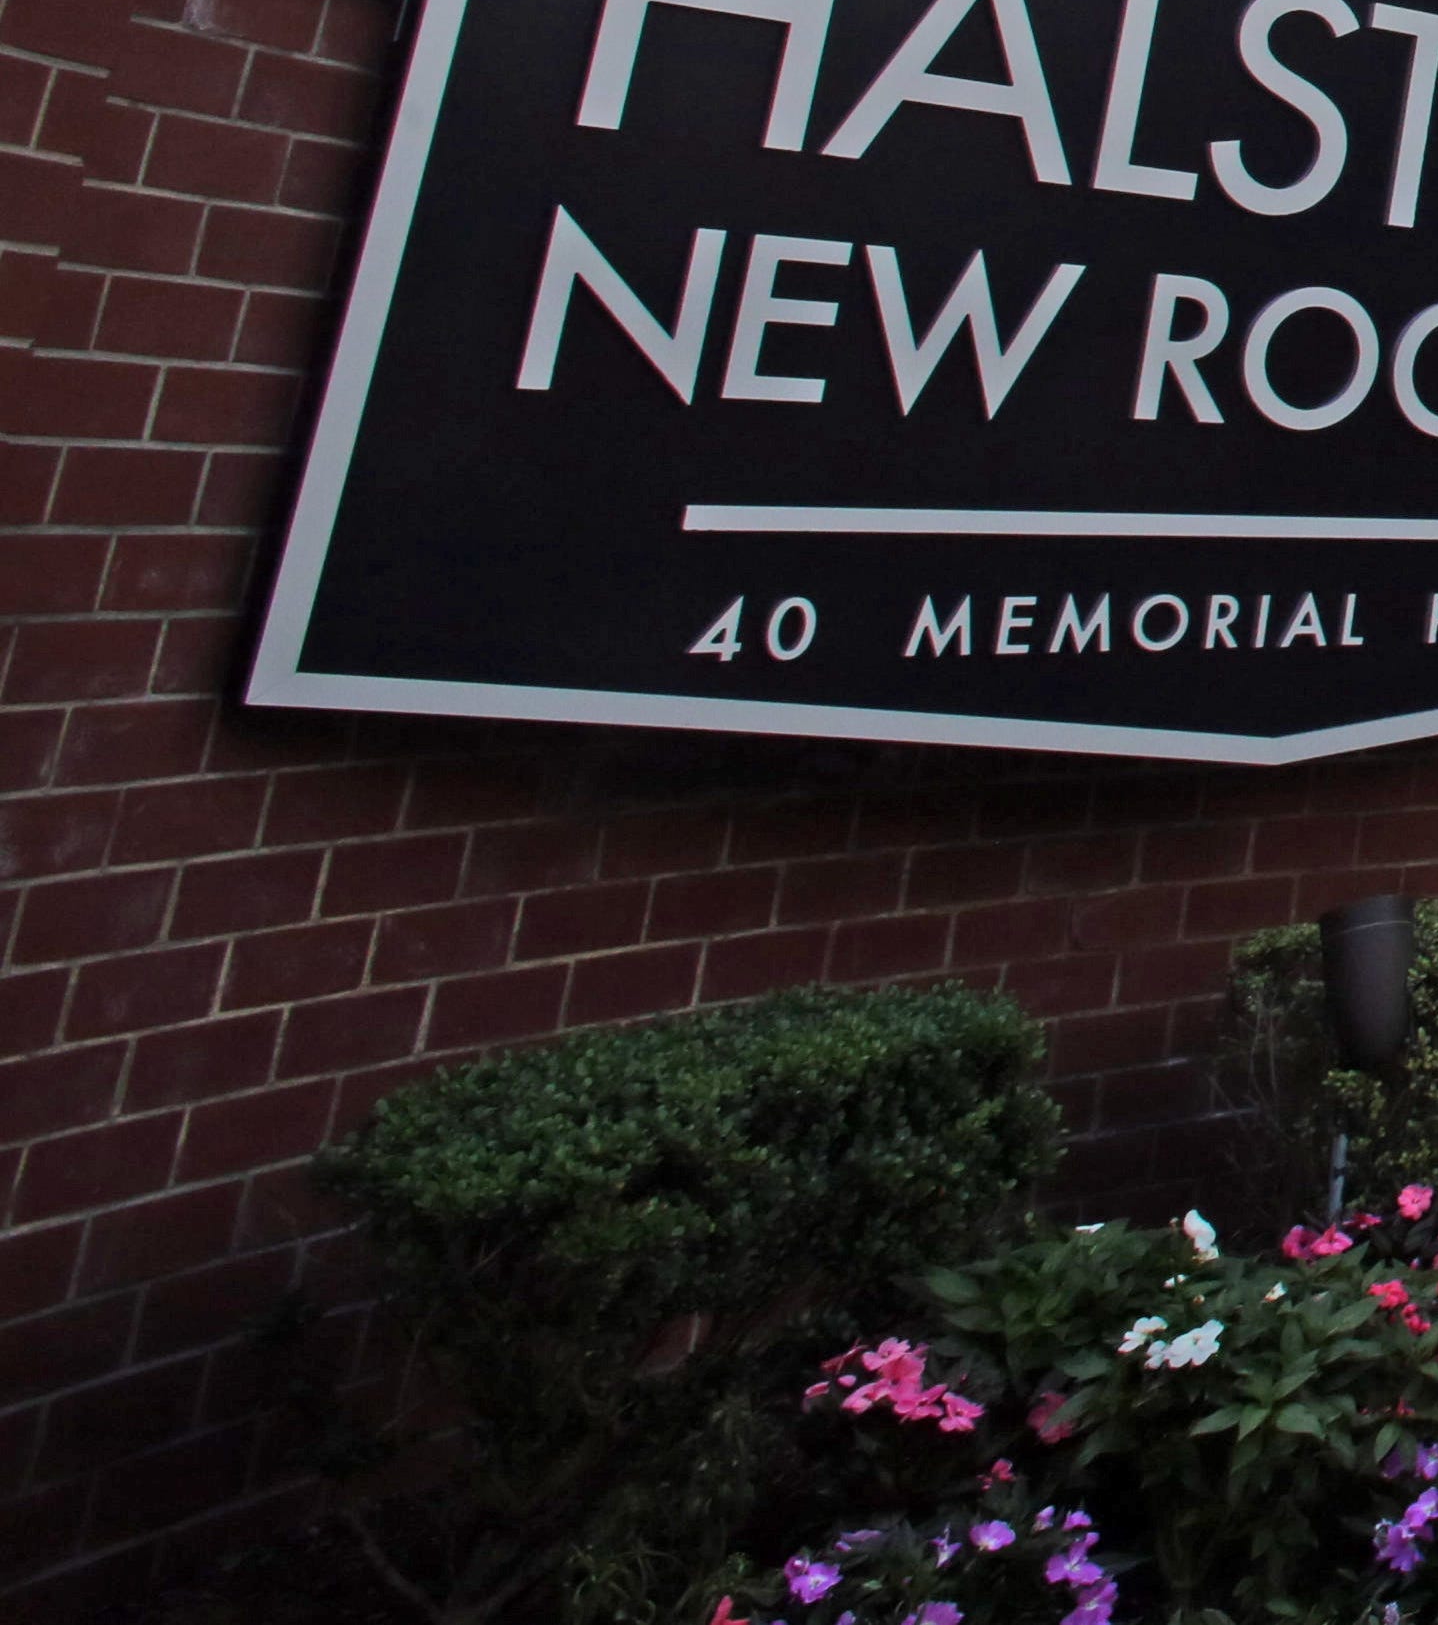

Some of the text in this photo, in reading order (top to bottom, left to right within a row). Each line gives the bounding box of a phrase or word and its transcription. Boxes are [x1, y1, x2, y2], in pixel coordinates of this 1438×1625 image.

[516, 204, 1086, 421] NEW
[686, 596, 818, 663] 40
[902, 592, 1364, 658] MEMORIAL
